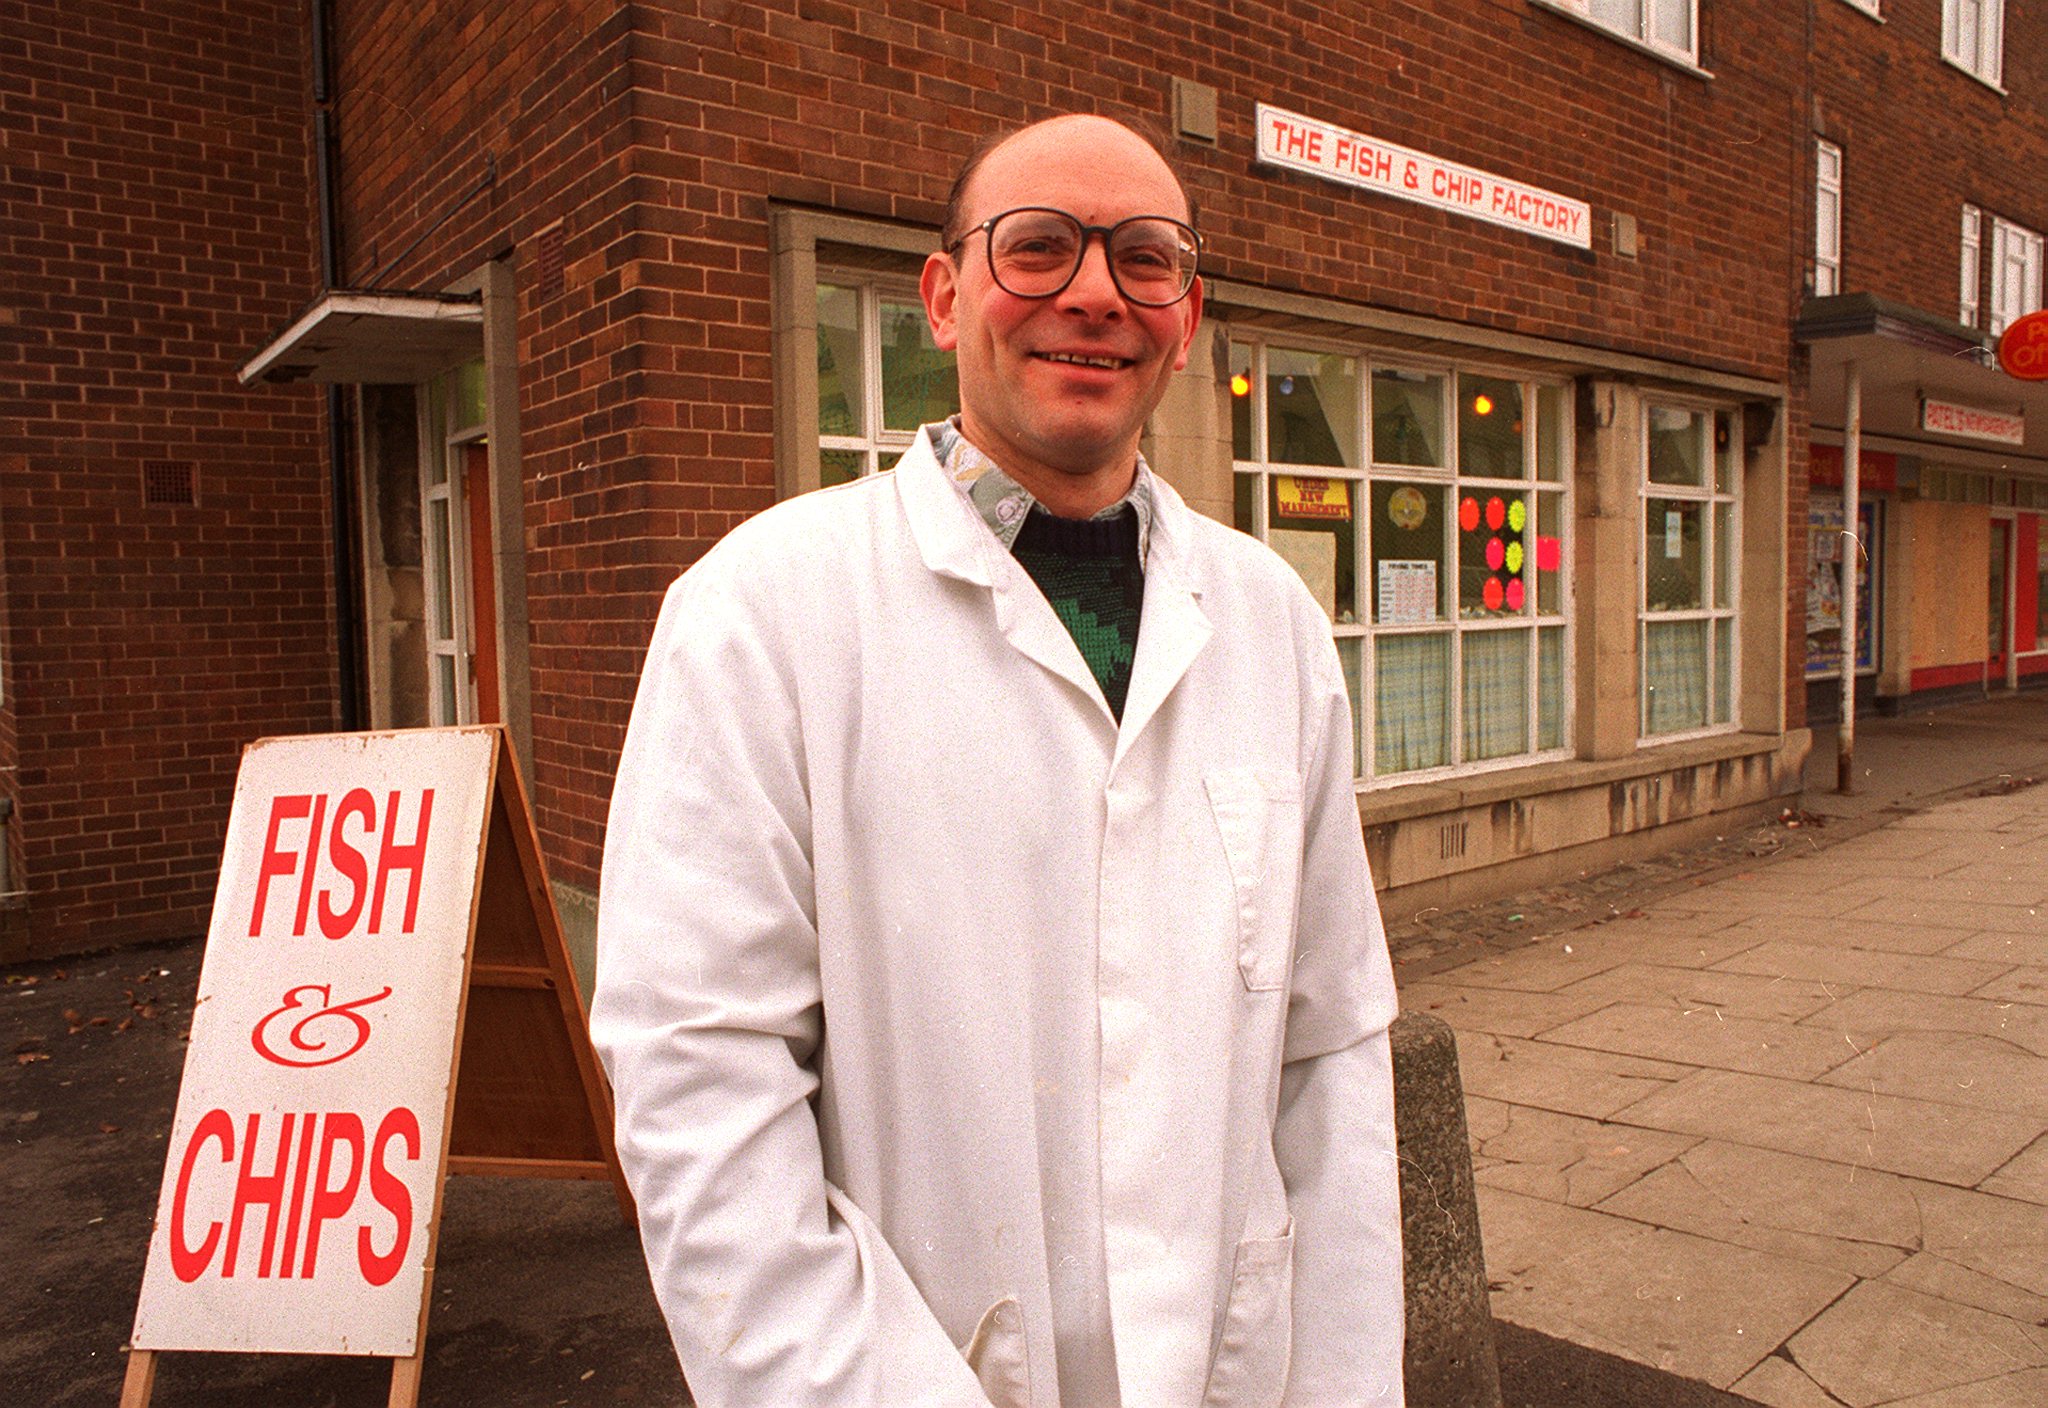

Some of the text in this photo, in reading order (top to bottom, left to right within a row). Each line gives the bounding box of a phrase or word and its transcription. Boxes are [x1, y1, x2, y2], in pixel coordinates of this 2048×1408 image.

[1272, 120, 1581, 234] THE FISH & CHIP FACTORY
[249, 787, 435, 940] FISH
[251, 984, 392, 1067] &
[170, 1107, 421, 1286] CHIPS
